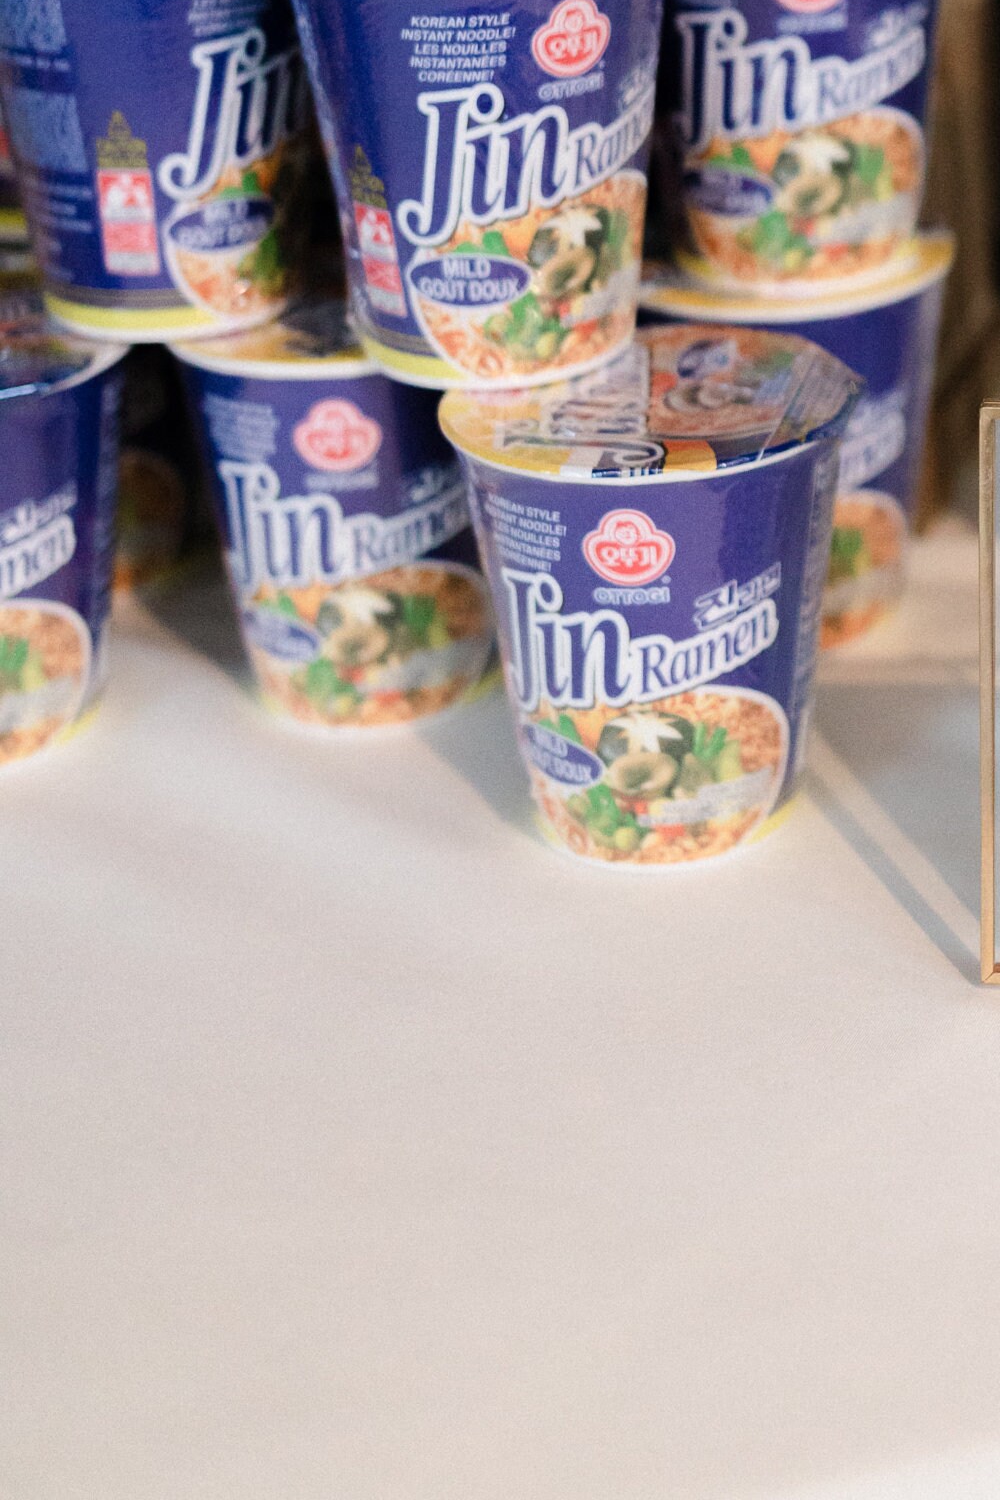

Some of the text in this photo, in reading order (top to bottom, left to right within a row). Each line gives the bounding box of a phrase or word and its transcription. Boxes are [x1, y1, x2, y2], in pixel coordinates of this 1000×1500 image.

[410, 13, 511, 30] KOREAN STYLE
[400, 27, 517, 42] INSTANT NOODLE!
[414, 41, 507, 56] LES NOUILLES
[397, 83, 569, 247] Jin
[442, 257, 492, 279] MILD
[468, 278, 521, 303] DOUX
[526, 506, 561, 522] STYLE
[510, 523, 561, 548] NOUILLES
[519, 515, 567, 537] NOODLE!
[592, 586, 671, 605] OTTOGI
[501, 567, 780, 710] Jin Ramen
